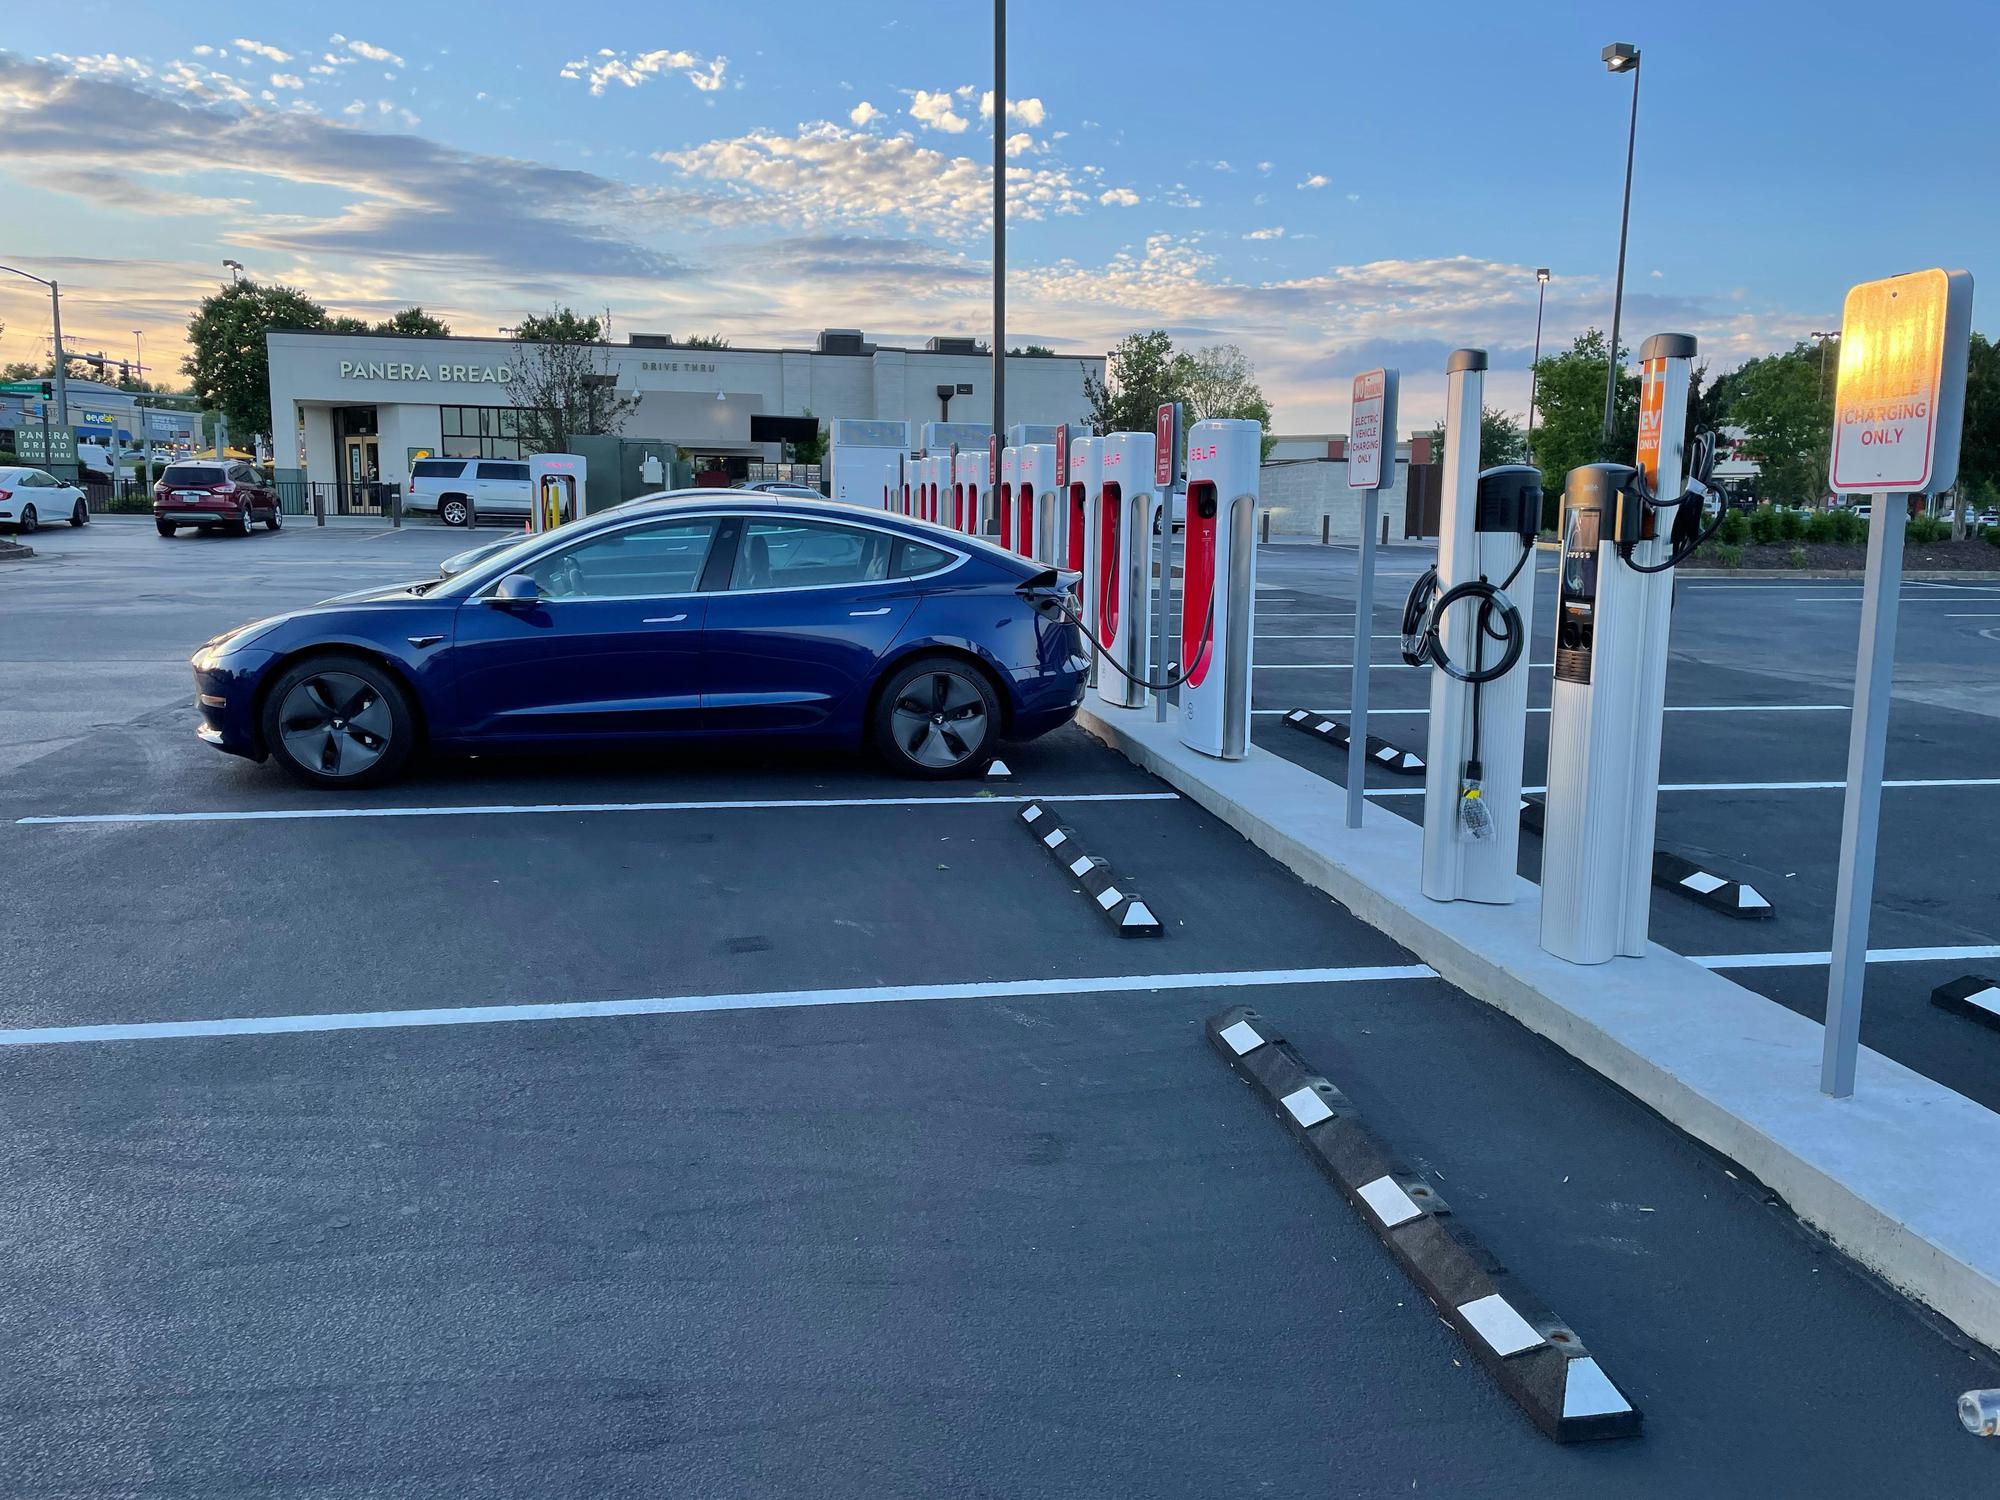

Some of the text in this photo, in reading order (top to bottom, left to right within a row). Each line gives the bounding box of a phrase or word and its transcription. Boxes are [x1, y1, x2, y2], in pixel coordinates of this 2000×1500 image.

[340, 360, 513, 383] PANERA BREAD
[642, 362, 715, 373] DRIVE THRU
[1641, 408, 1662, 431] EV
[1845, 402, 1926, 425] CHARGING
[1355, 414, 1378, 426] ELECTRIC
[1356, 427, 1376, 438] VEHICLE
[1861, 427, 1904, 446] ONLY
[1353, 440, 1378, 451] CHARGING
[1639, 439, 1659, 450] ONLY
[1190, 444, 1217, 461] ESLA
[1357, 454, 1371, 463] ONLY
